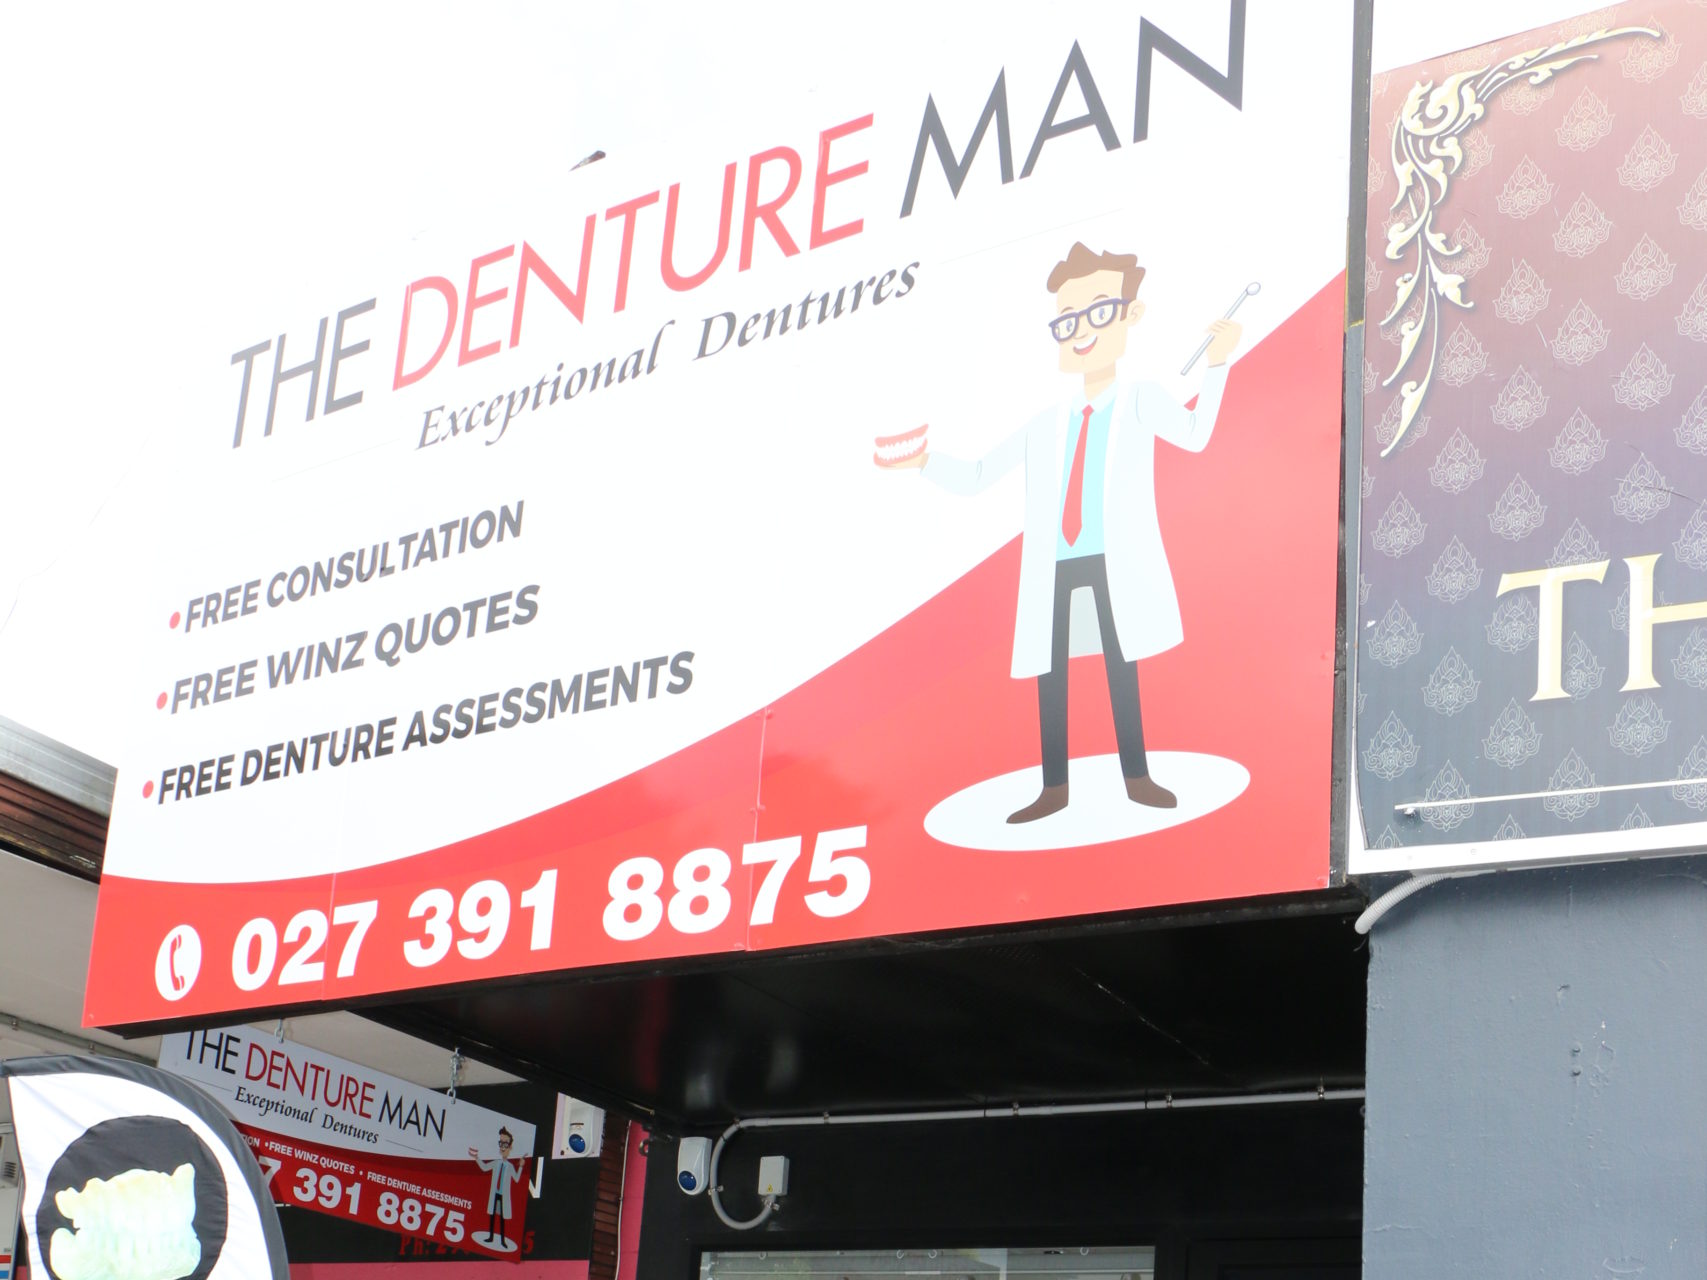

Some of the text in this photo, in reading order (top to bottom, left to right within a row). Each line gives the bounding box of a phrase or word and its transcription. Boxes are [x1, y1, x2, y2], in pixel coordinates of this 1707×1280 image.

[231, 0, 1247, 449] THE DENTURE MAN
[415, 257, 920, 451] Exceptional Dentures
[184, 500, 524, 633] FREE CONSULTATION
[172, 585, 540, 714] FREE WINZ QUOTES
[158, 651, 695, 805] FREE DENTURE ASSESSMENTS
[231, 826, 871, 992] 027 391 8875
[186, 1029, 446, 1142] THE DENTURE MAN
[234, 1086, 380, 1144] Exceptional Dentures
[268, 1141, 473, 1210] FREE WINZ QUOTES FREE DENTURE ASSESSMENTS
[293, 1167, 362, 1216] 391
[376, 1191, 466, 1243] 8875
